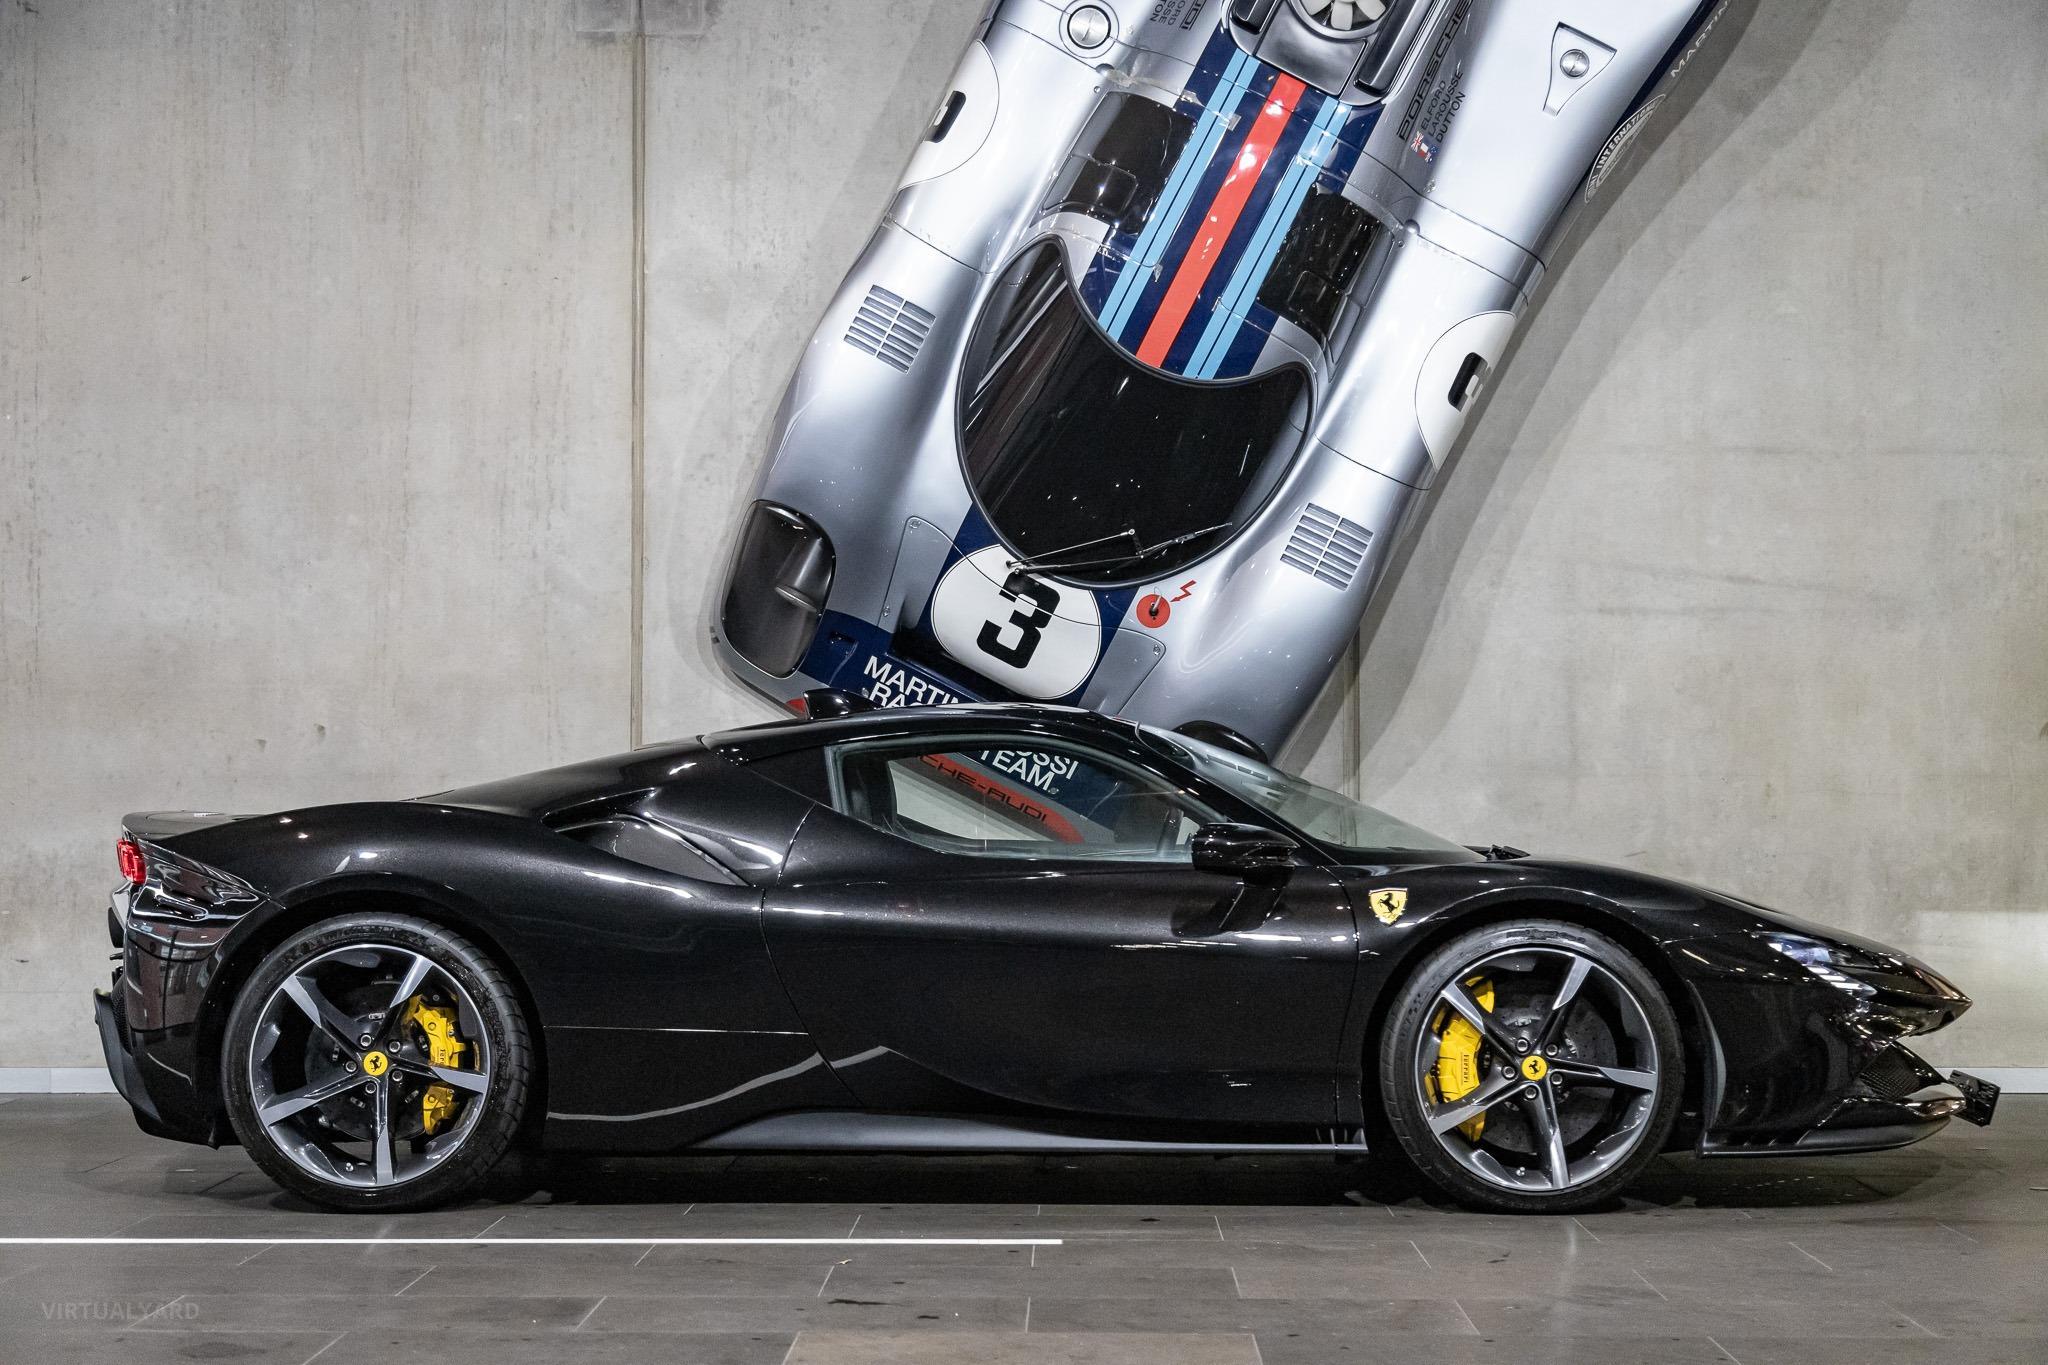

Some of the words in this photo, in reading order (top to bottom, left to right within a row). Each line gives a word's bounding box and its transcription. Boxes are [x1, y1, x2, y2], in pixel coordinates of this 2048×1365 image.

[1420, 80, 1447, 131] ELFORD
[1428, 71, 1464, 137] LAROUSSE
[1436, 91, 1467, 144] DUTTON
[976, 571, 1061, 669] 3
[863, 655, 960, 705] MARTI
